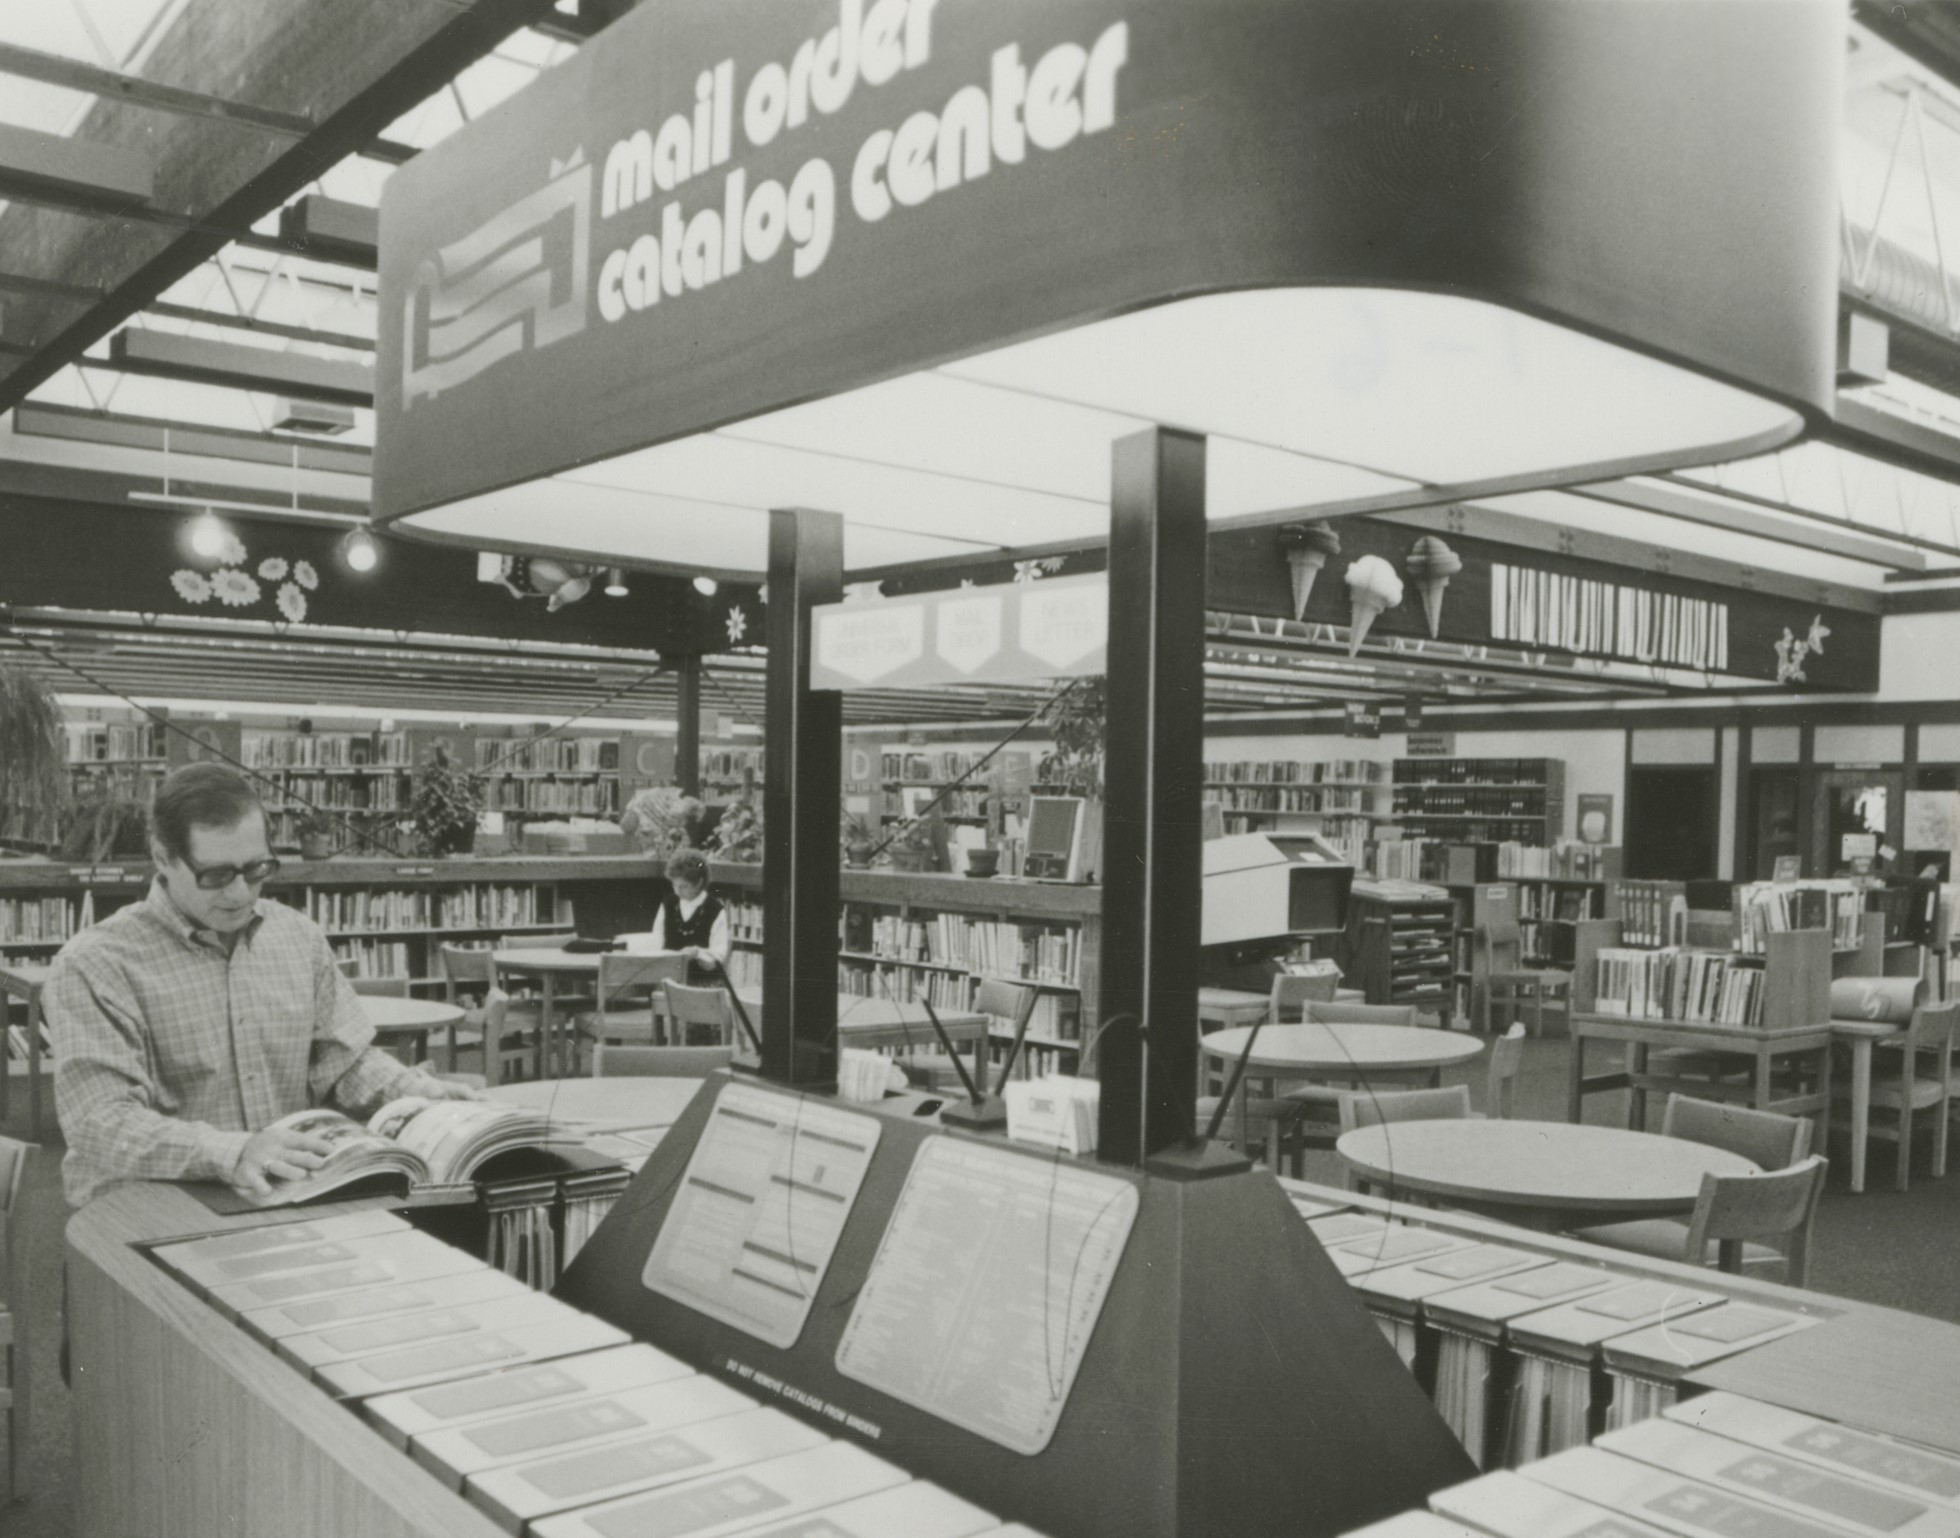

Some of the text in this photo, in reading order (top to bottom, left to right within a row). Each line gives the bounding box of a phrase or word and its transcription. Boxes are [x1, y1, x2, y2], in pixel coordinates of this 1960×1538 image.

[601, 0, 941, 220] mail order
[598, 20, 1129, 323] catalog center
[636, 743, 656, 775] C
[851, 749, 871, 781] D
[726, 1359, 738, 1373] DO
[738, 1365, 754, 1379] NOT
[754, 1371, 782, 1393] REMOVE
[783, 1385, 823, 1412] CATALOGS
[823, 1403, 847, 1423] FROM
